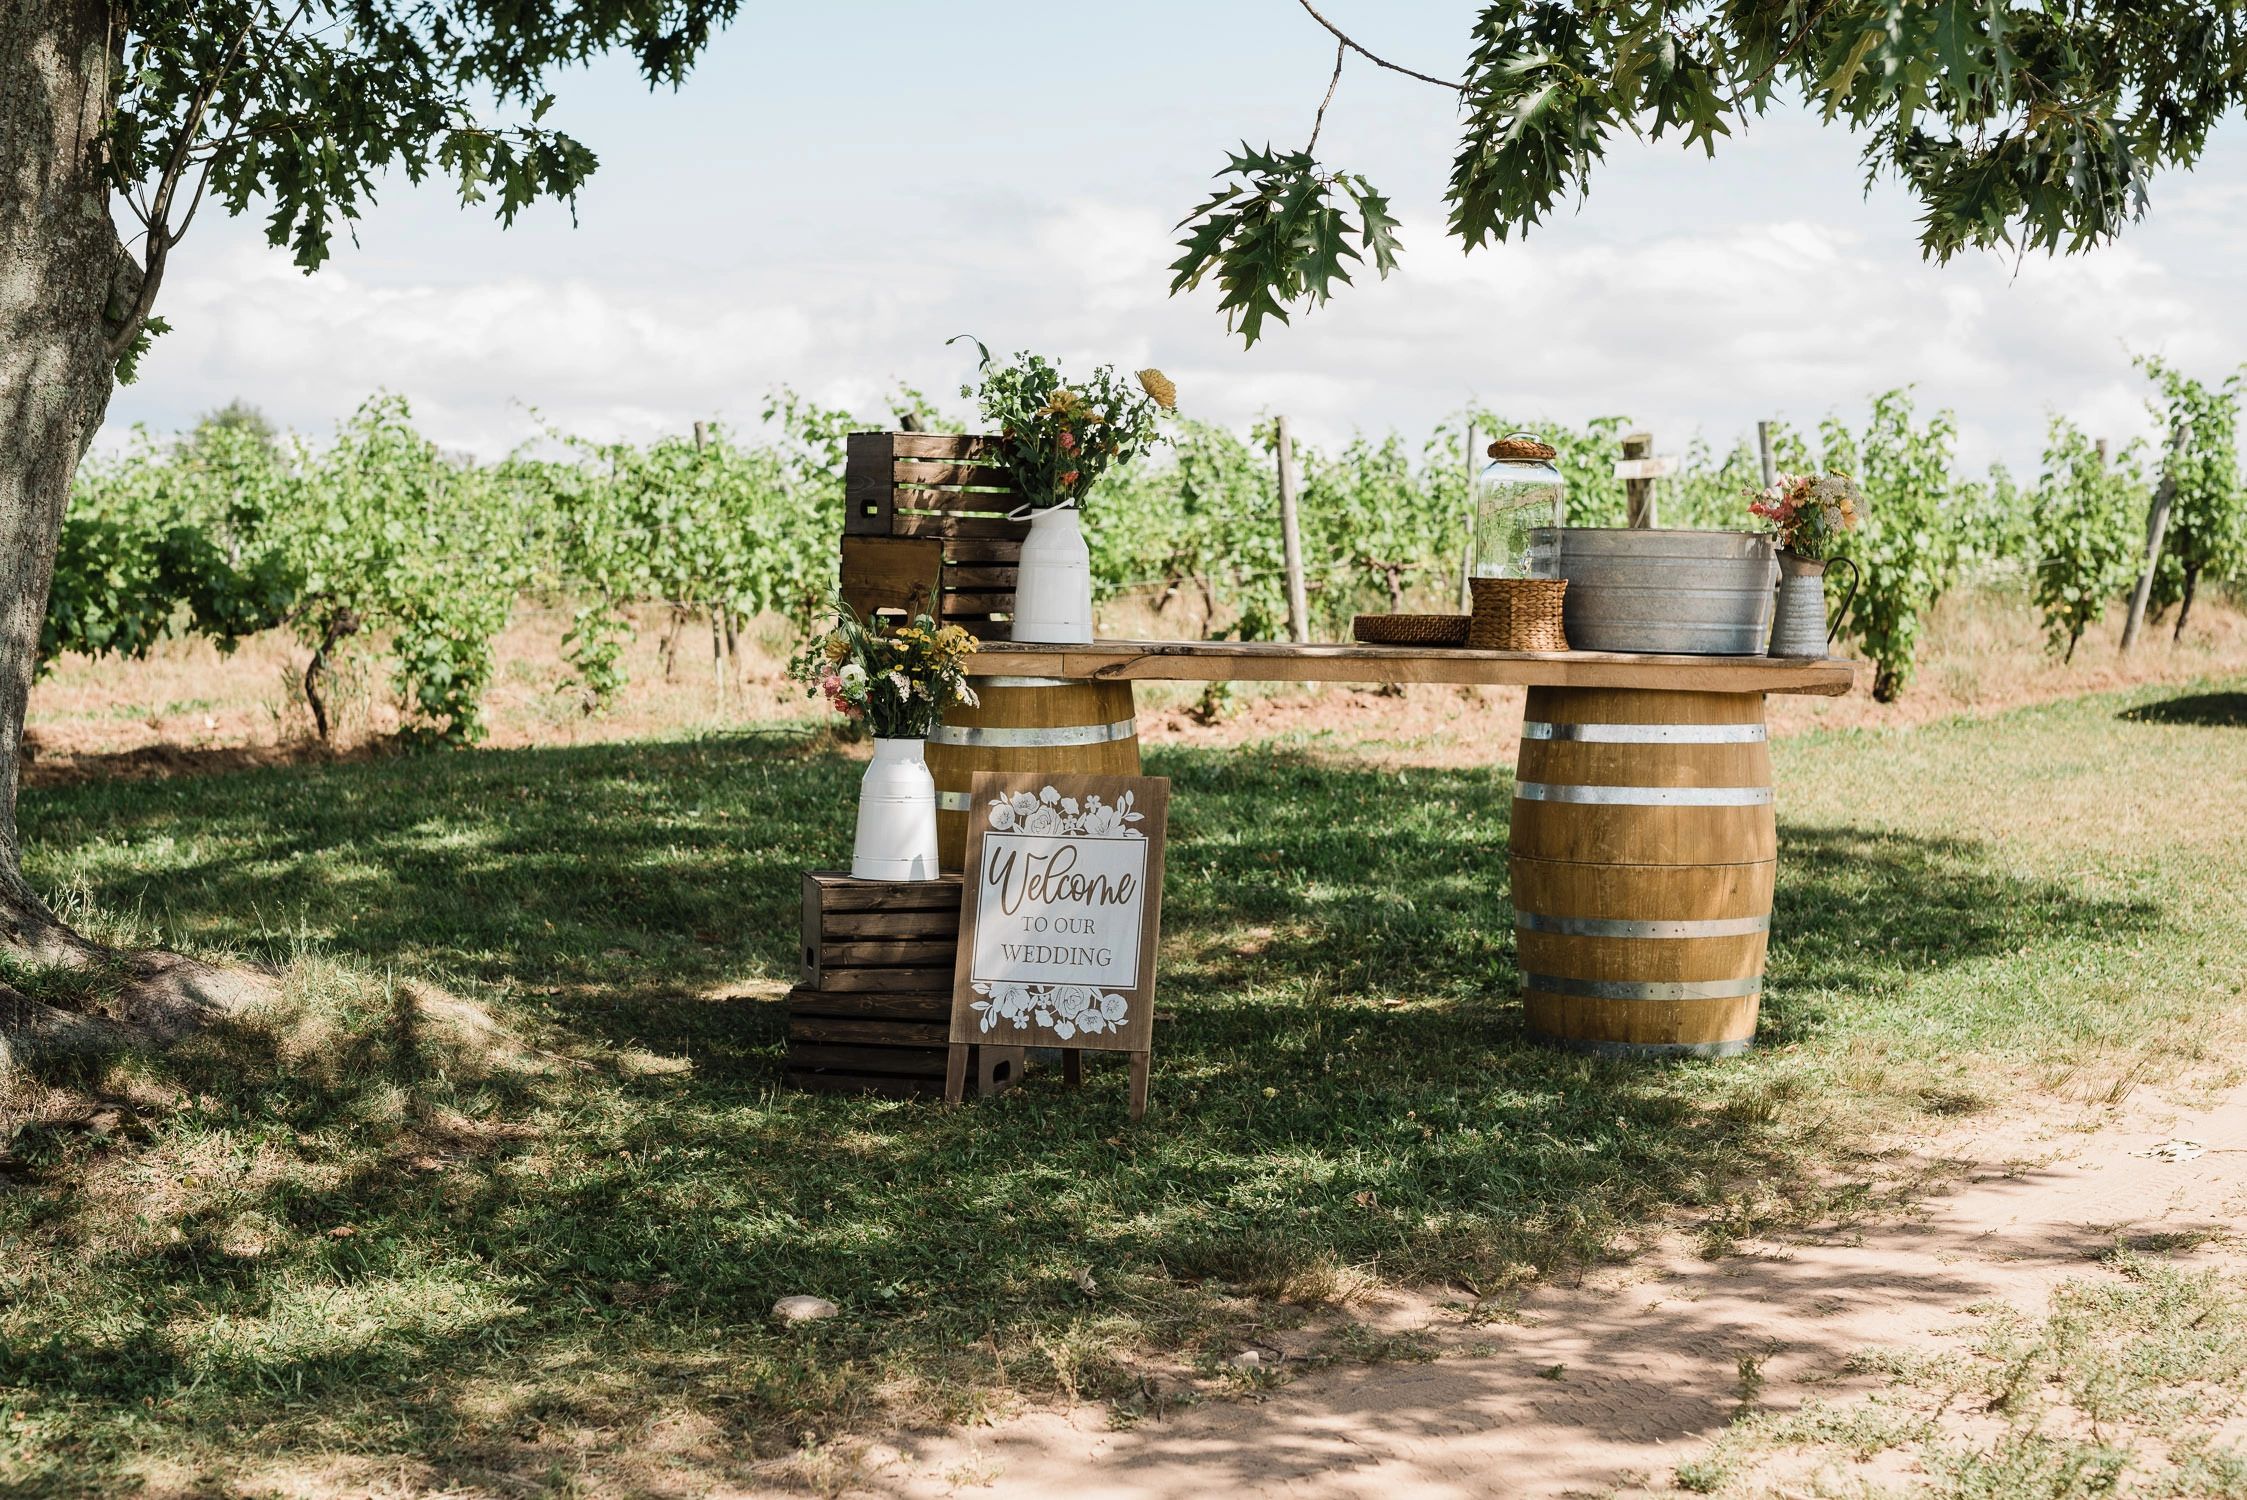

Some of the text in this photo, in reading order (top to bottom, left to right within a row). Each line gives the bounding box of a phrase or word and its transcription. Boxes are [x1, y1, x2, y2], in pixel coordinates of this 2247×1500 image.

[988, 844, 1137, 916] Welcome
[1021, 916, 1095, 935] TO OUR
[1000, 943, 1113, 968] WEDDING
